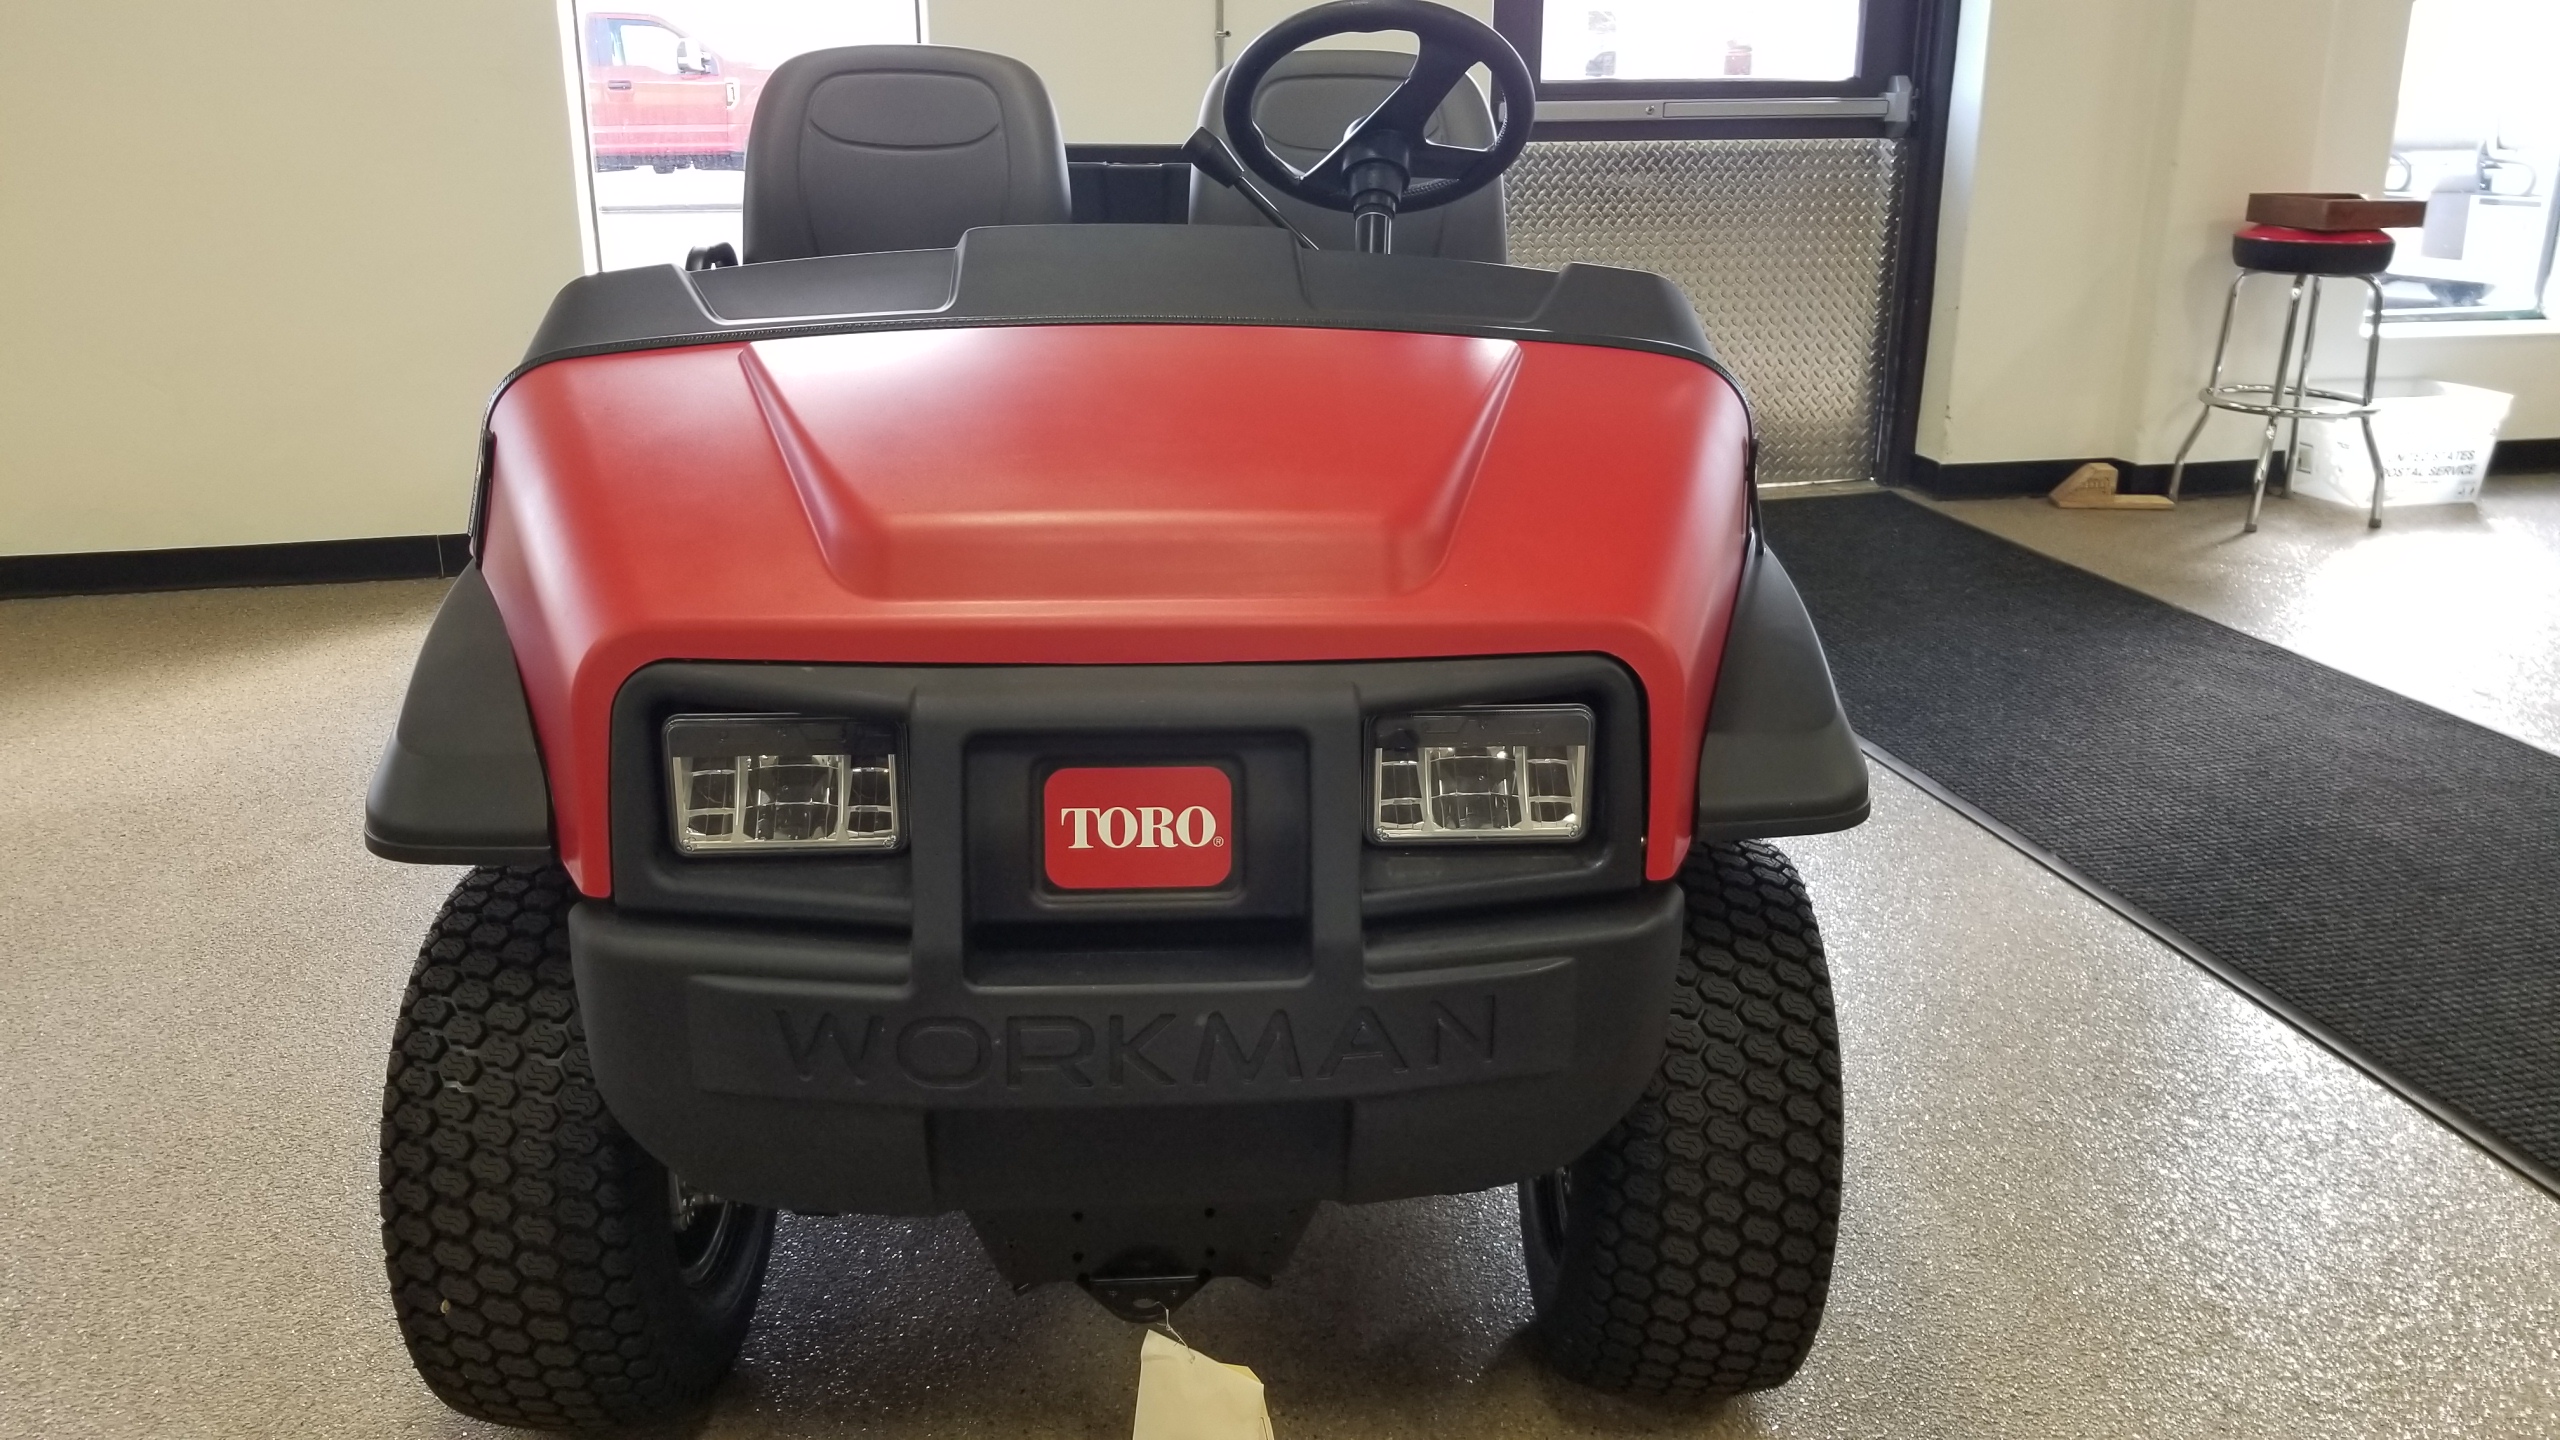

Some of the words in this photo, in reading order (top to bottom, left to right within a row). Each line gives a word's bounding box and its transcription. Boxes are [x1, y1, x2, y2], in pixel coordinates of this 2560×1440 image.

[2428, 463, 2476, 477] SERVICE
[1061, 806, 1217, 848] TORO
[774, 995, 1497, 1089] WORKMAN
